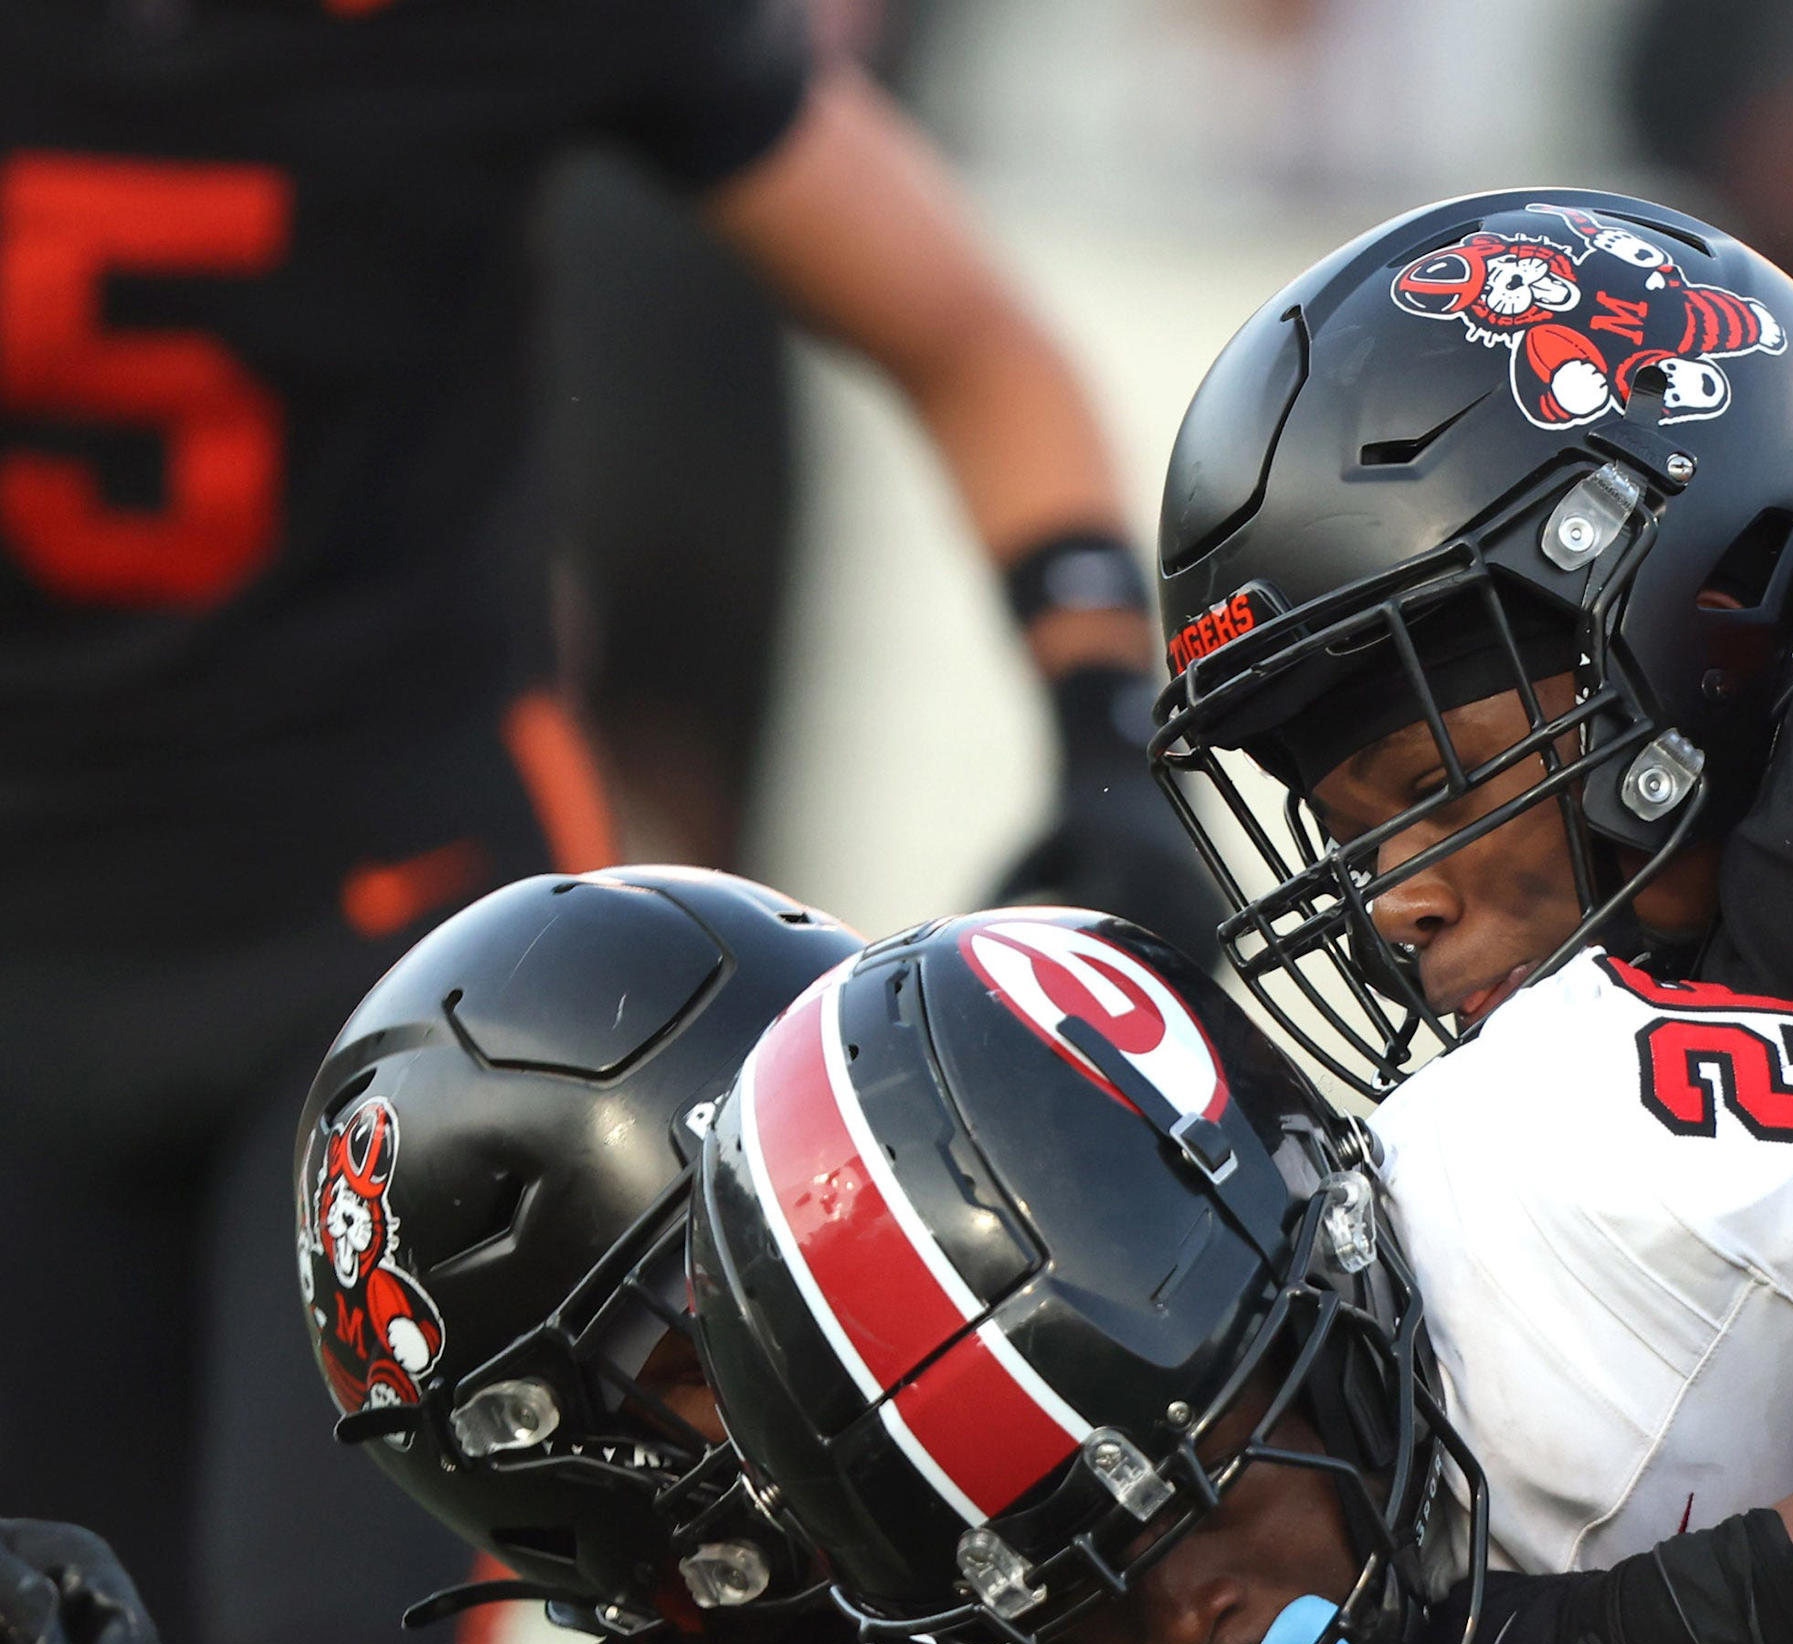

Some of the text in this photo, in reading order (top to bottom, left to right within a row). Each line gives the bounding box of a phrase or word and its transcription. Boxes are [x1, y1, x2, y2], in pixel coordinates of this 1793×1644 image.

[1590, 290, 1648, 346] M
[0, 148, 292, 606] 5
[1168, 594, 1255, 675] TIGERS
[335, 1291, 369, 1360] M
